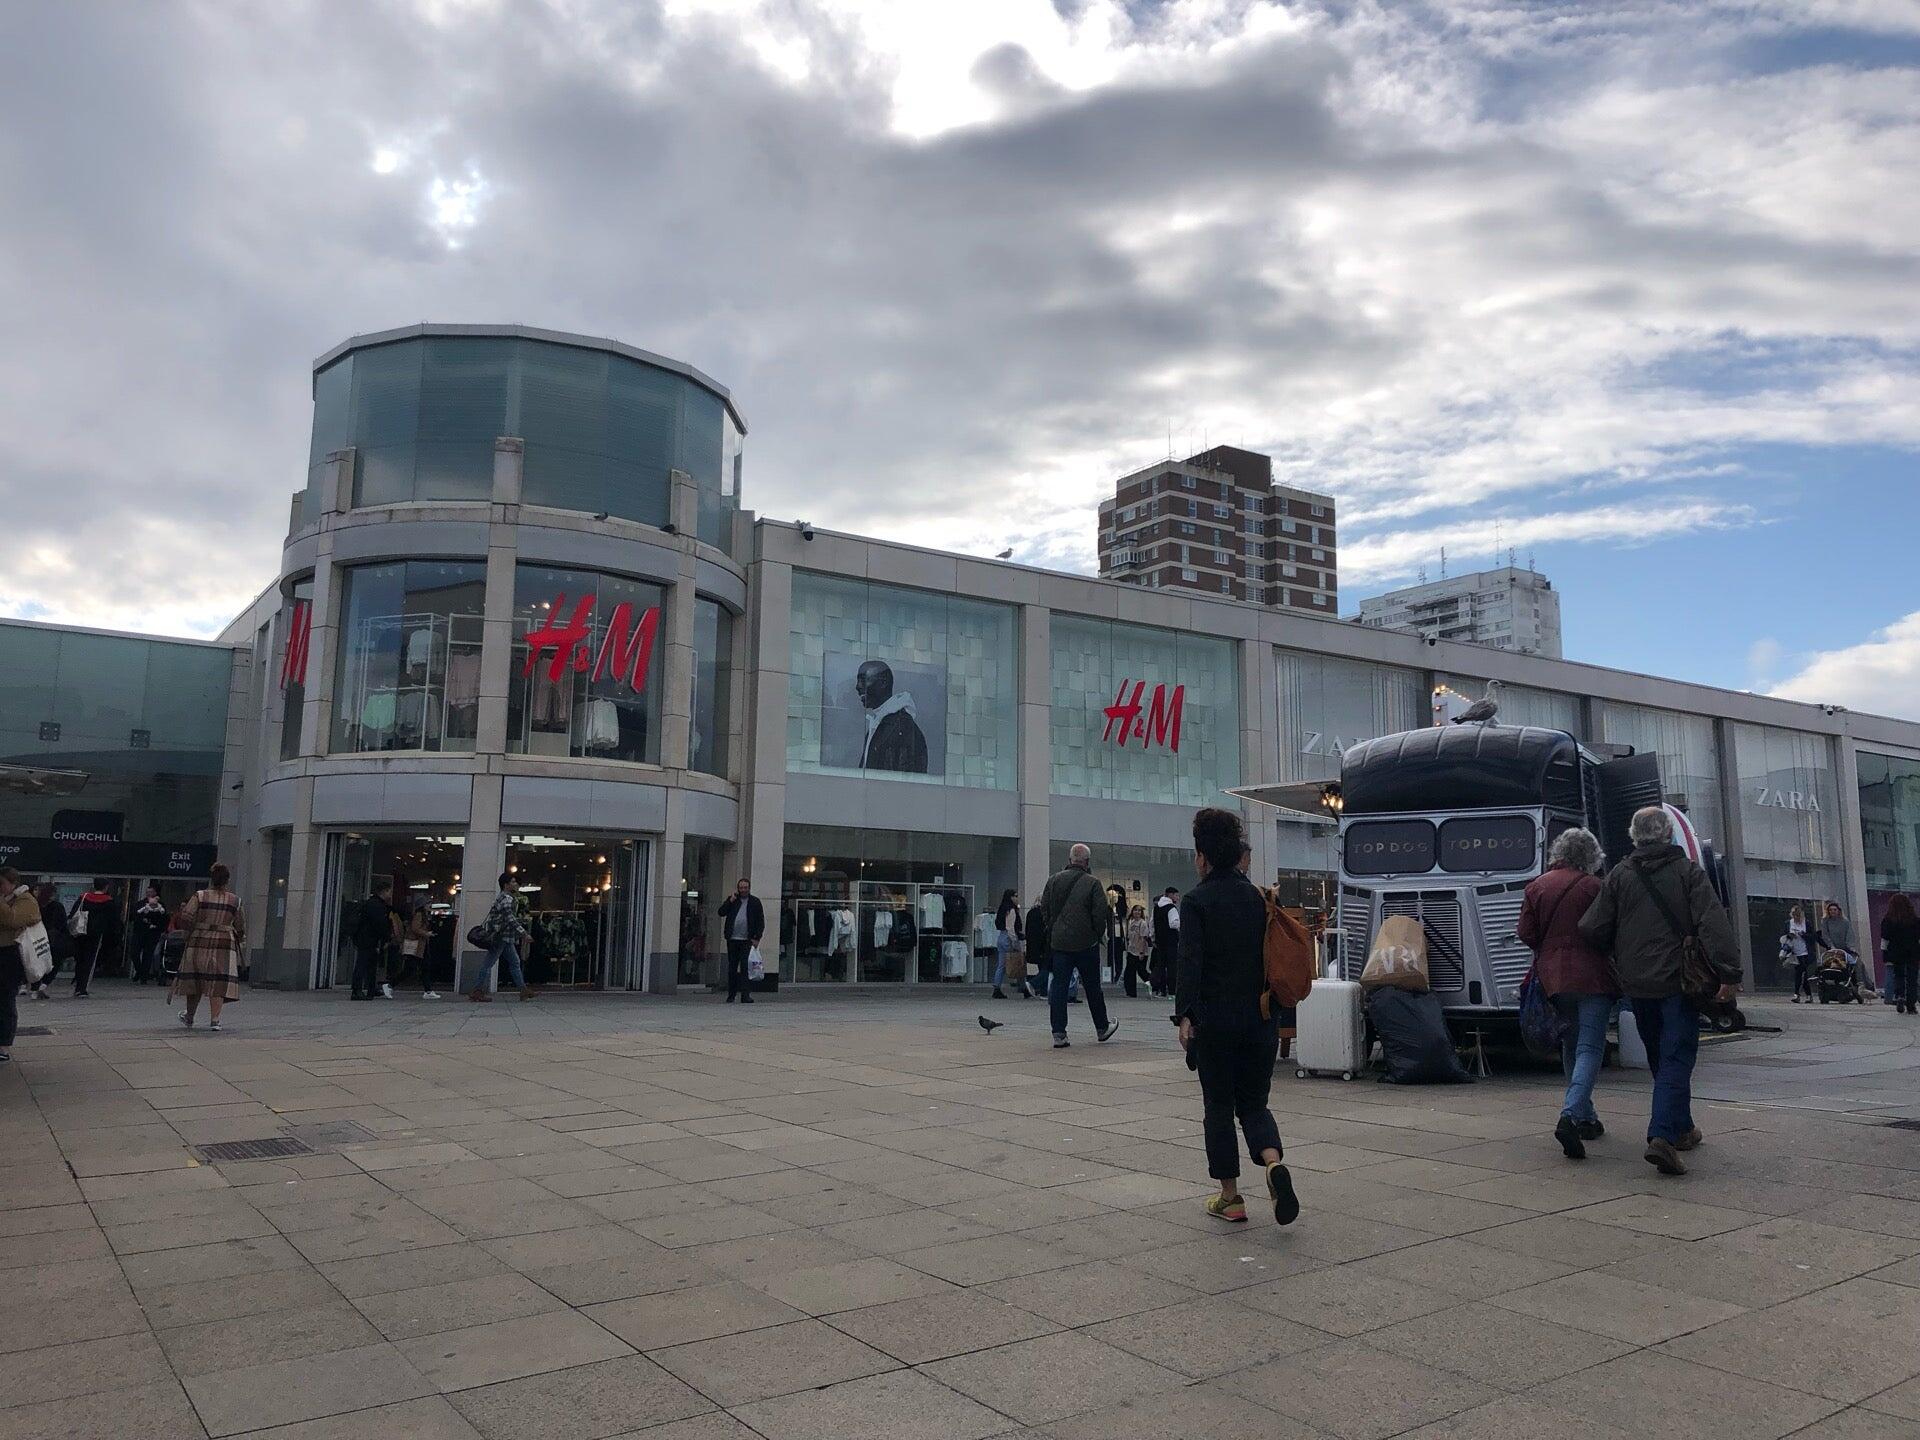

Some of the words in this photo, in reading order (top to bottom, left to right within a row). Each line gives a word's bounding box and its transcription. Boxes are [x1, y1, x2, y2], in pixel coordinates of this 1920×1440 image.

[522, 591, 661, 694] H&M
[1102, 678, 1185, 754] H&M
[1299, 731, 1367, 758] ZA
[1755, 786, 1822, 812] ZARA
[53, 831, 120, 843] CHURCHILL
[1352, 842, 1385, 854] TOP
[1448, 838, 1482, 850] TOP
[171, 851, 191, 861] Exit
[168, 861, 192, 872] Only
